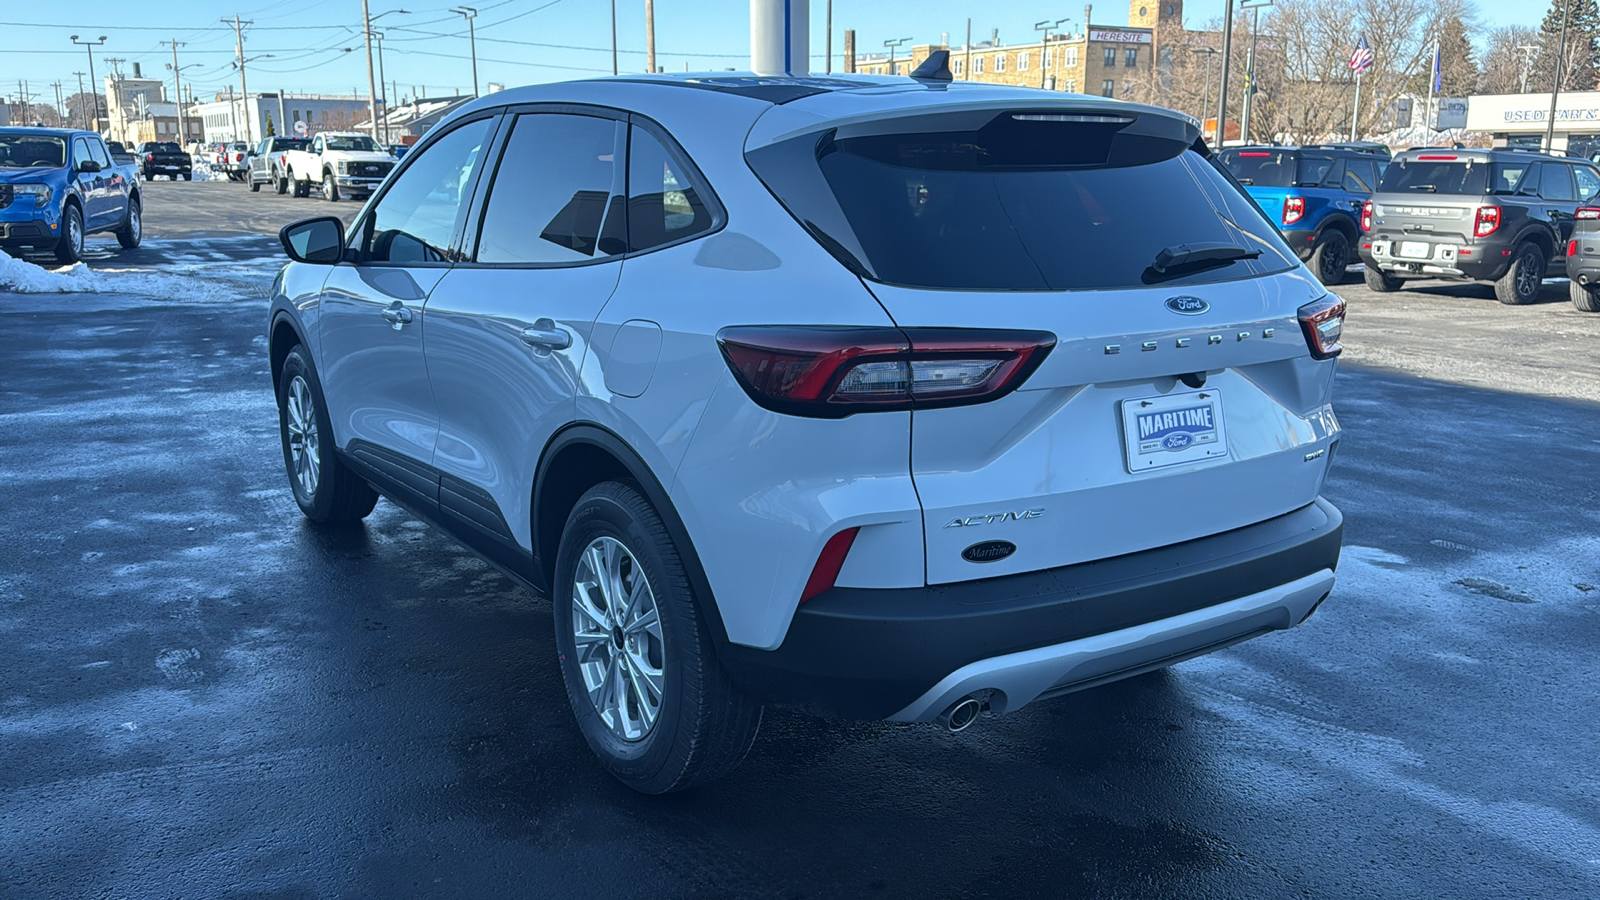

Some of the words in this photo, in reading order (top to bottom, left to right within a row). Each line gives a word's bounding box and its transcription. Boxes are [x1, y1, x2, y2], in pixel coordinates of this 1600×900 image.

[1096, 32, 1144, 42] HERESITE
[1504, 110, 1543, 121] USED
[1103, 327, 1275, 355] ESCAPE
[1138, 406, 1213, 440] MARITIME
[1167, 435, 1188, 448] Ford
[942, 506, 1046, 530] ACTIVE
[969, 545, 1012, 560] Maritime
